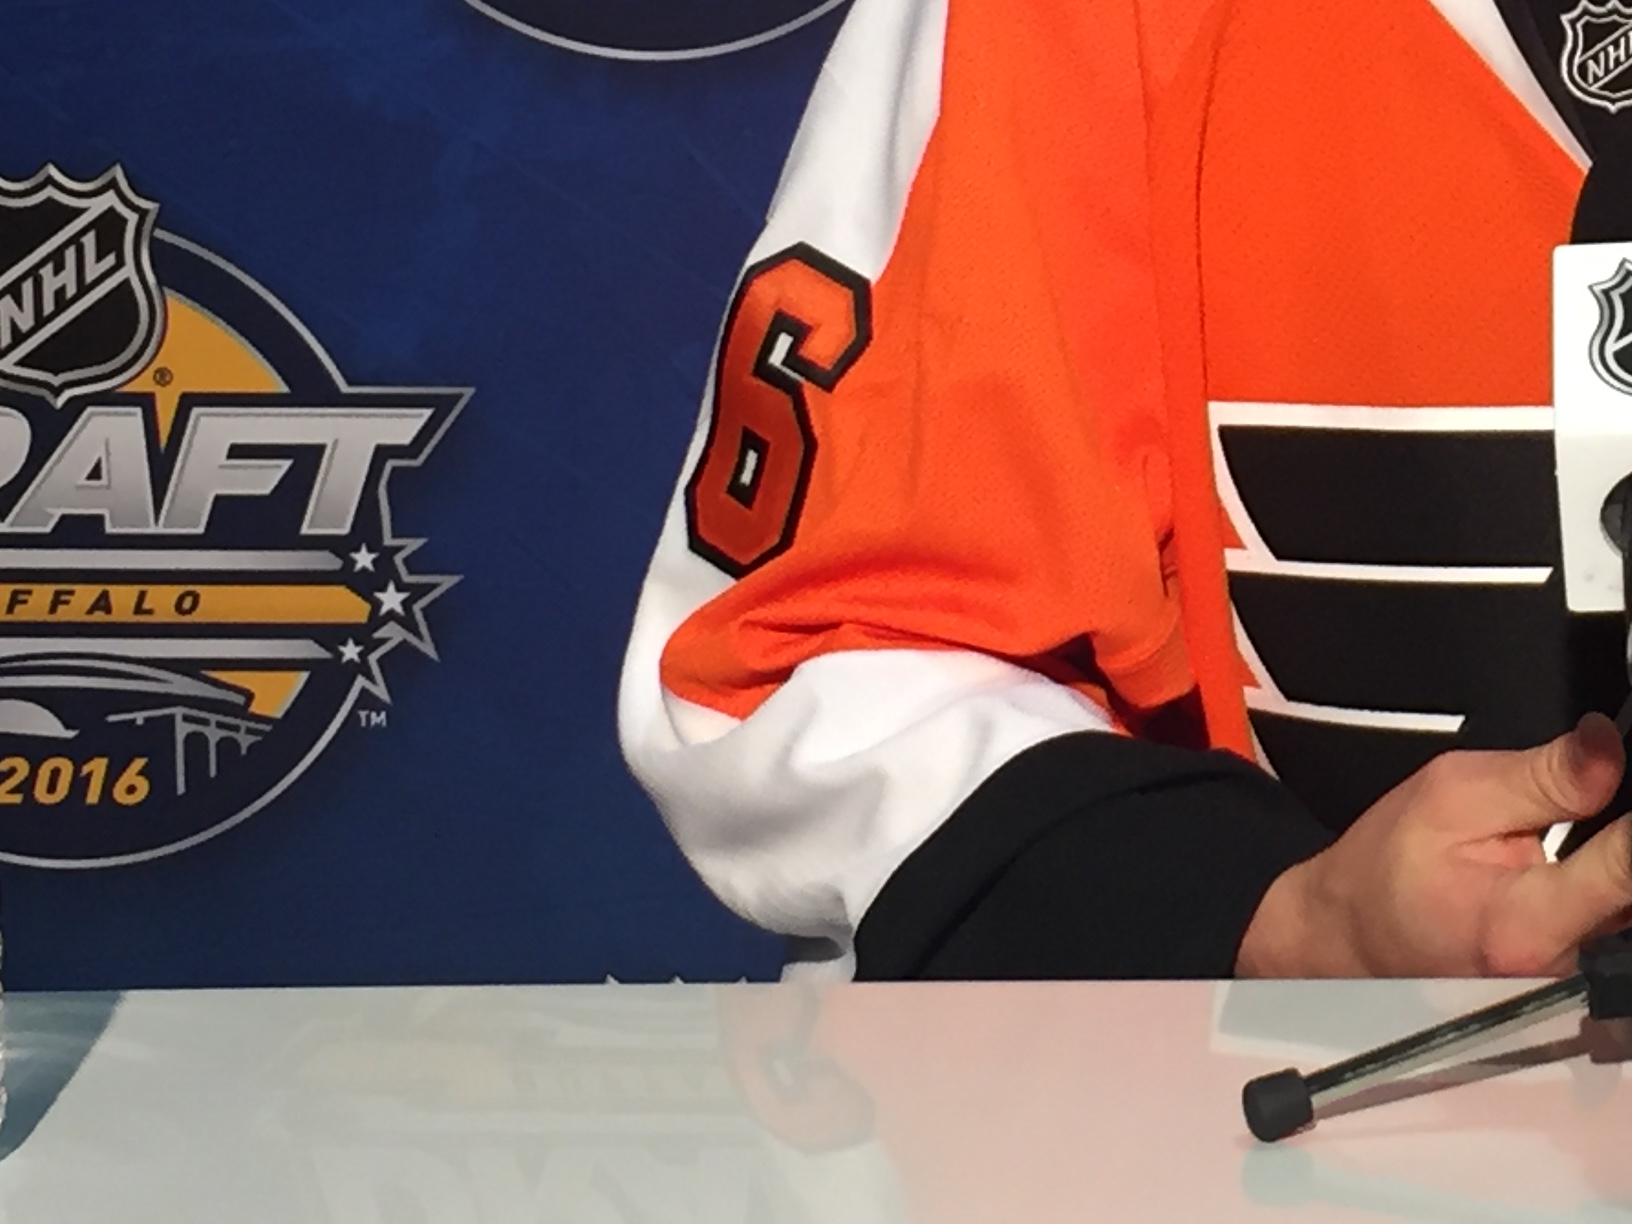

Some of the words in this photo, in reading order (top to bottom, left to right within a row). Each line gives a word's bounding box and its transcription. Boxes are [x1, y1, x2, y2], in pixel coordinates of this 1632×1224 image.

[0, 230, 117, 343] NHL
[685, 242, 873, 579] 6
[0, 406, 435, 535] AFT
[6, 589, 200, 617] FFALO
[357, 709, 387, 728] TM
